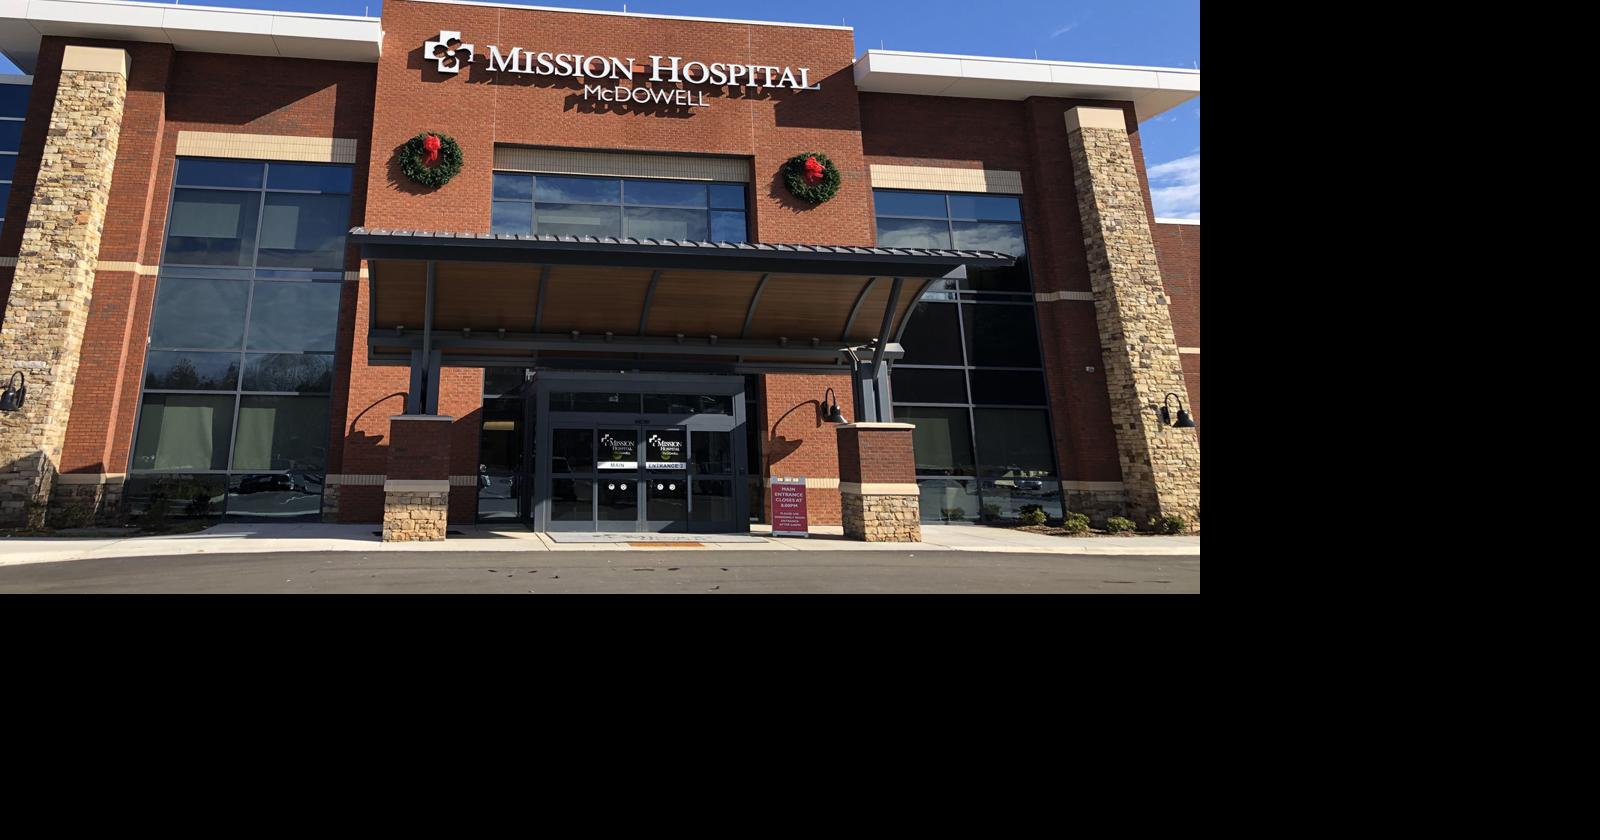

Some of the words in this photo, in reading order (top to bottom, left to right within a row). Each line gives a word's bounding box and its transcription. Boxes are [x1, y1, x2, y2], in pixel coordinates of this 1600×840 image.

[485, 45, 636, 80] MISSION
[648, 55, 821, 90] HOSPITAL
[584, 84, 710, 107] McDOWELL
